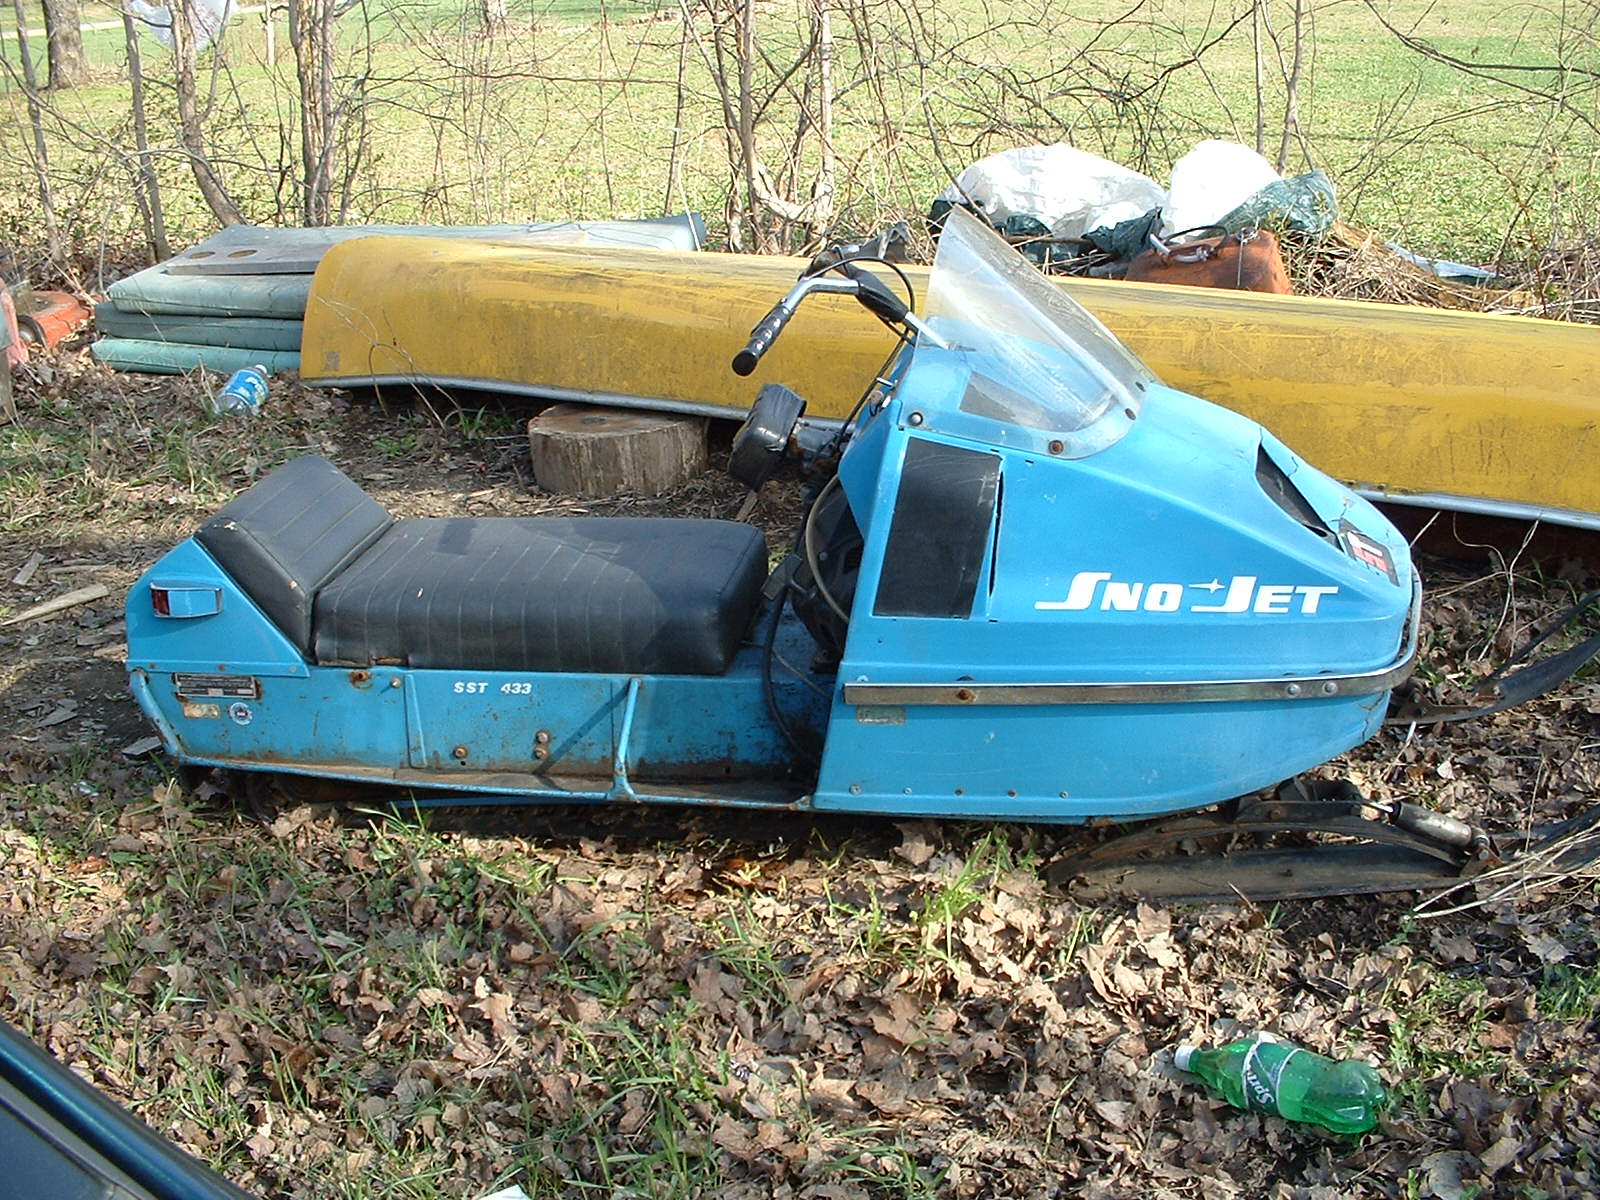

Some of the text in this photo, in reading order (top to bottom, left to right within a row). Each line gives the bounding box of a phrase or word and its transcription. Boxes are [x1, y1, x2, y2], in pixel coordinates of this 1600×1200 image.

[1034, 572, 1339, 614] SNO JET
[453, 681, 532, 695] SST 433
